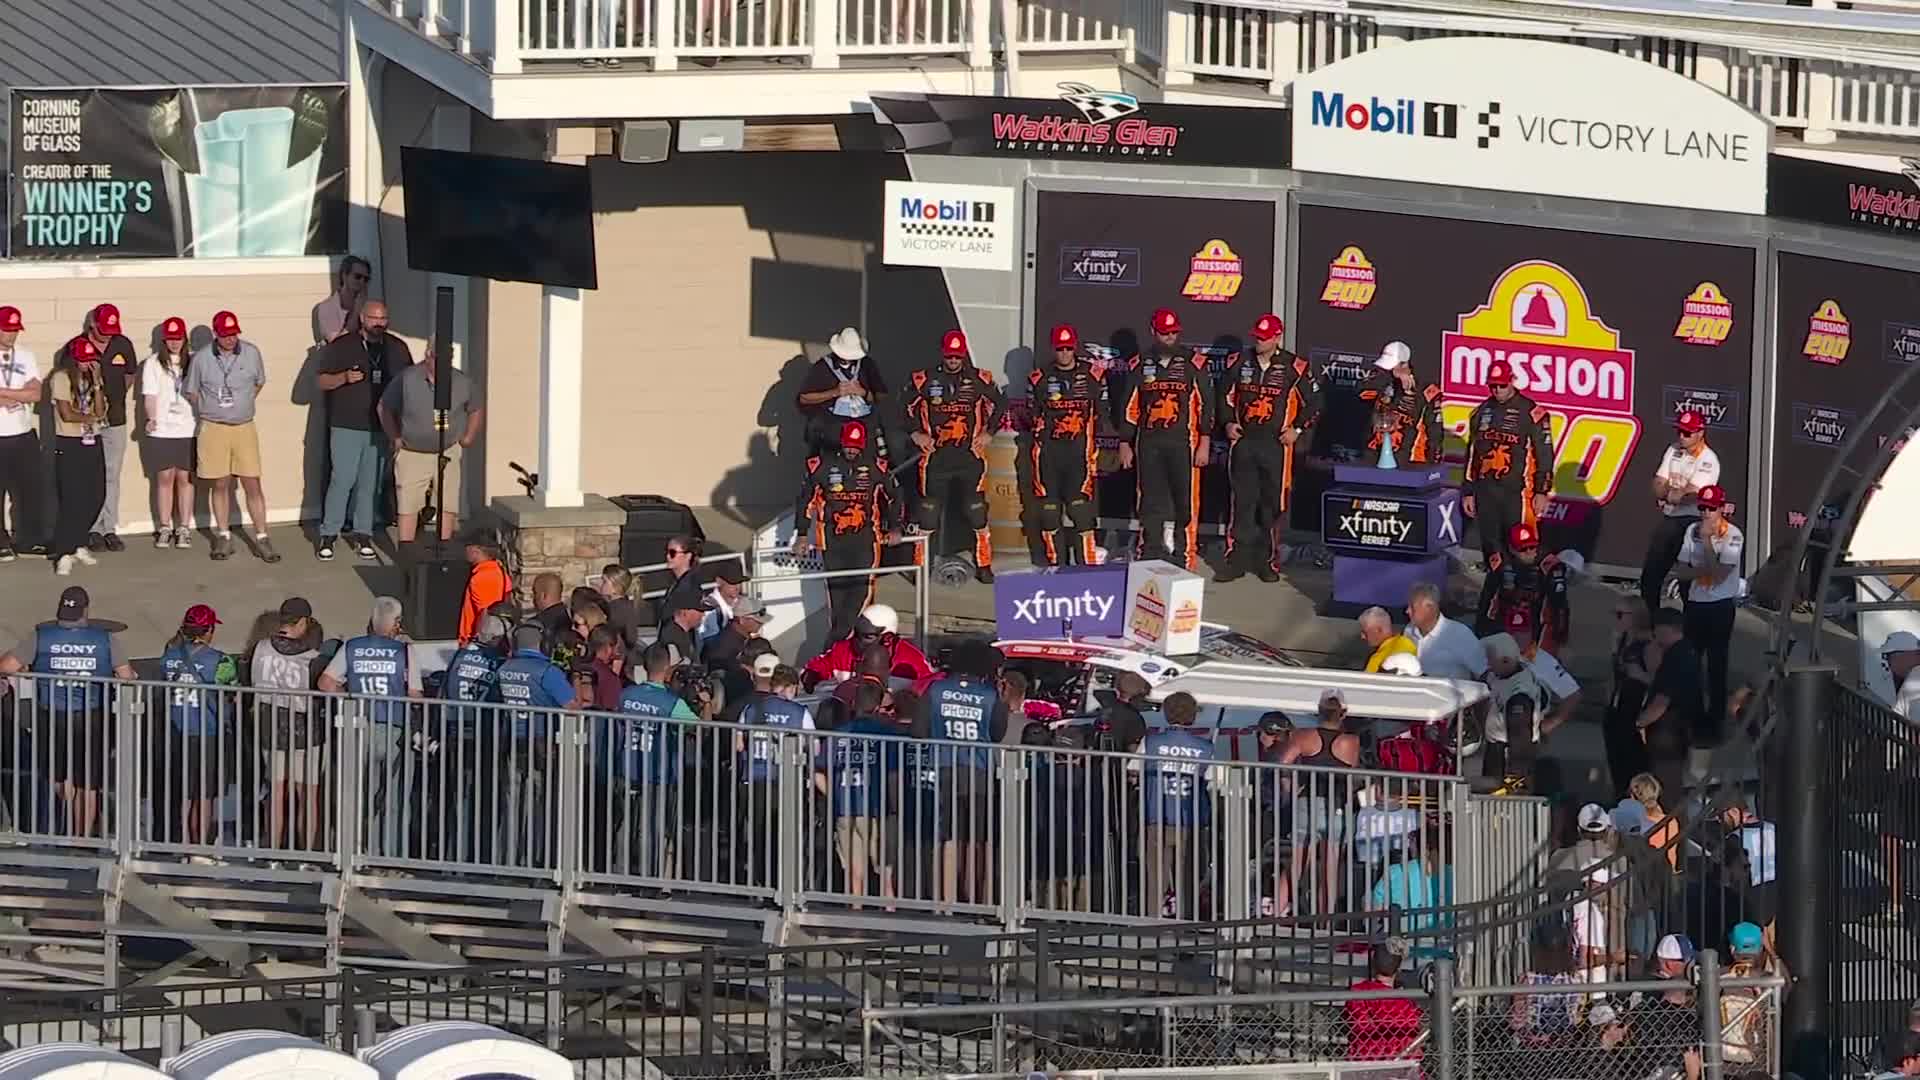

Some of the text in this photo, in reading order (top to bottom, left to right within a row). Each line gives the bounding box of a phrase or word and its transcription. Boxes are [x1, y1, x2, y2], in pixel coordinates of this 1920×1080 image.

[22, 99, 80, 116] CORNING
[22, 117, 80, 134] MUSEUM
[992, 112, 1179, 147] Watkins Glen
[1312, 91, 1414, 135] Mobil
[1518, 115, 1654, 152] VICTORY
[1664, 128, 1749, 162] LANE
[23, 135, 80, 152] OF GLASS
[996, 142, 1174, 156] INTERNATIONAL
[23, 164, 112, 179] CREATOR OF THE
[23, 180, 152, 214] WINNER'S
[901, 198, 967, 221] Mobil
[22, 214, 124, 246] TROPHY
[901, 238, 992, 253] VICTORY LANE
[1073, 258, 1127, 278] xfinity
[1182, 274, 1242, 296] 200
[1674, 316, 1732, 340] 200
[1674, 398, 1728, 420] xfinity
[1803, 416, 1846, 440] xfinity
[1363, 500, 1400, 512] NASCAR
[1340, 510, 1412, 542] xfinity
[1360, 535, 1391, 546] SERIES
[1013, 590, 1115, 624] xfinity
[50, 644, 96, 654] SONY
[354, 648, 398, 658] SONY
[50, 657, 96, 669] PHOTO
[353, 660, 396, 674] PHOTO
[360, 676, 388, 695] 115
[942, 690, 984, 704] SONY
[624, 700, 660, 714] SONY
[940, 704, 983, 720] PHOTO
[944, 720, 978, 740] 196
[1159, 745, 1202, 758] SONY
